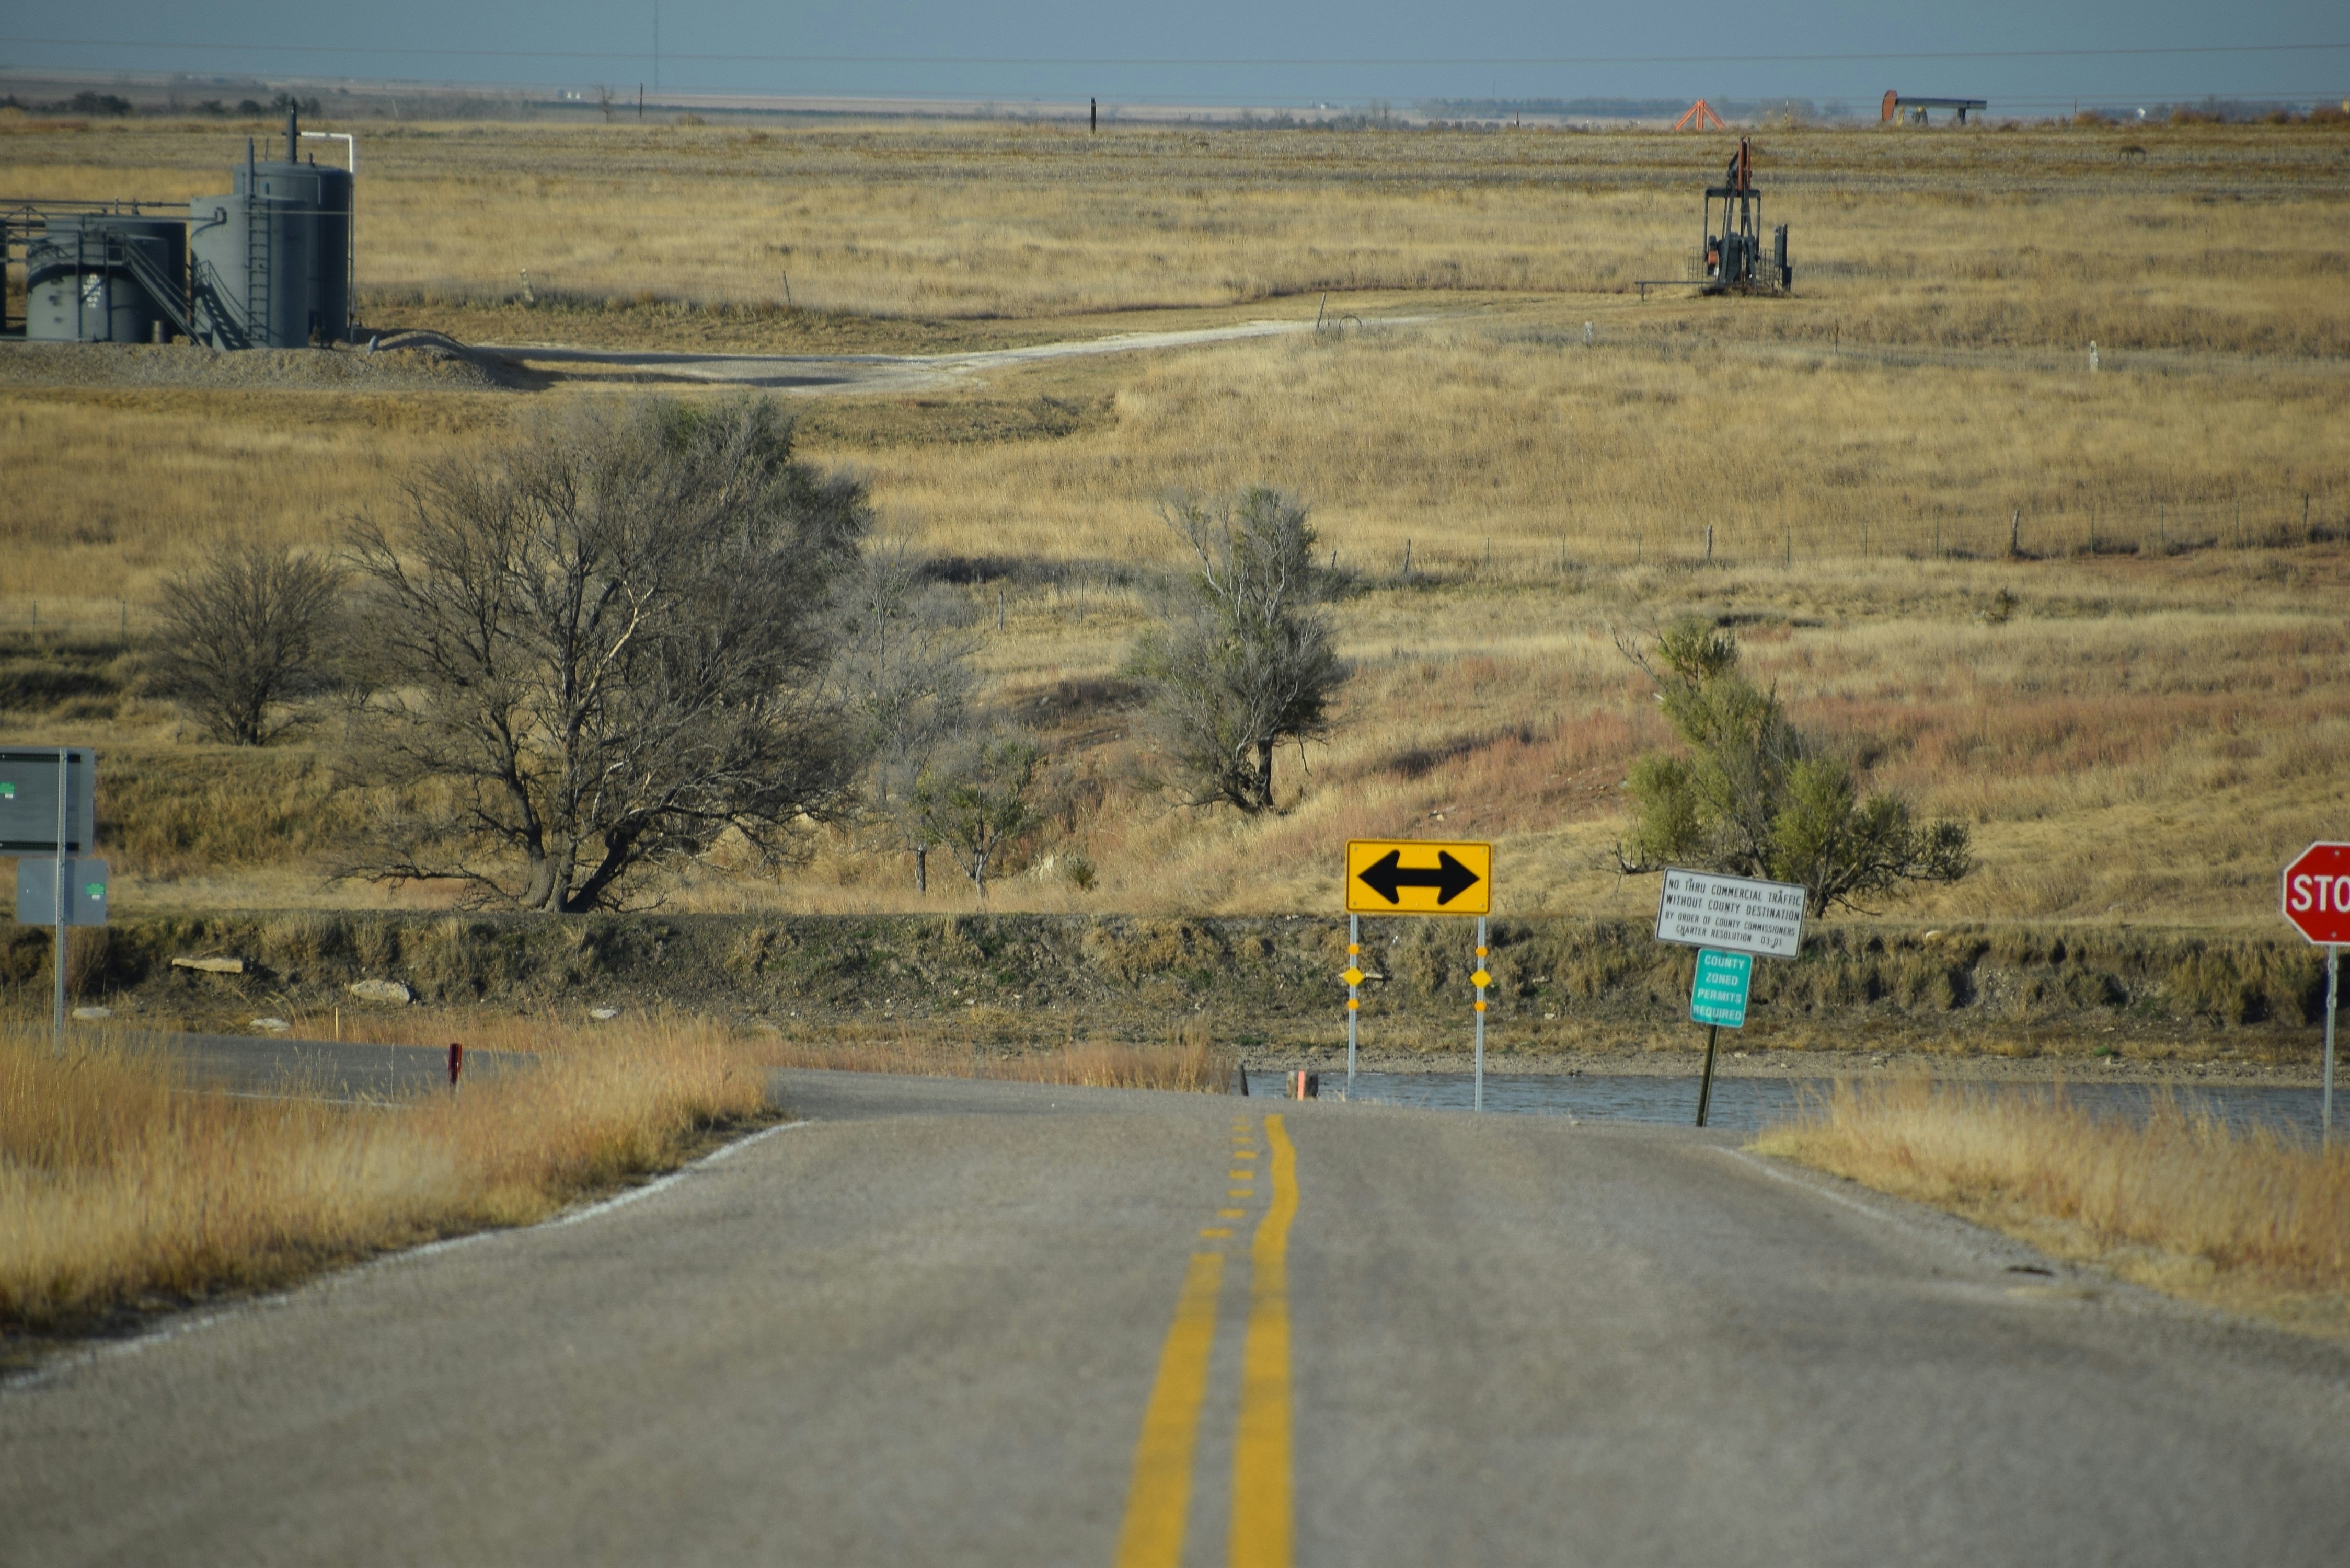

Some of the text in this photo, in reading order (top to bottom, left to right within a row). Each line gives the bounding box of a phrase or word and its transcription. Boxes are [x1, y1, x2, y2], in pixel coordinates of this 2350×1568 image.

[1668, 879, 1801, 906] NO THRU COMMERCIAL TRAFFIC
[1666, 894, 1800, 921] WITHOUT COUNTY DESTINATION
[1665, 911, 1674, 919] BY
[1678, 913, 1698, 923] ORDER
[1715, 918, 1740, 928] COUNTY
[1744, 922, 1795, 936] COMMISSIONERS
[1676, 925, 1706, 936] CHARTER
[1711, 930, 1752, 942] RESOLUTION
[1704, 955, 1745, 970] COUNTY
[1706, 972, 1738, 986] ZONED
[1698, 988, 1742, 1004] PERMITS
[1693, 1005, 1742, 1021] REQUIRED
